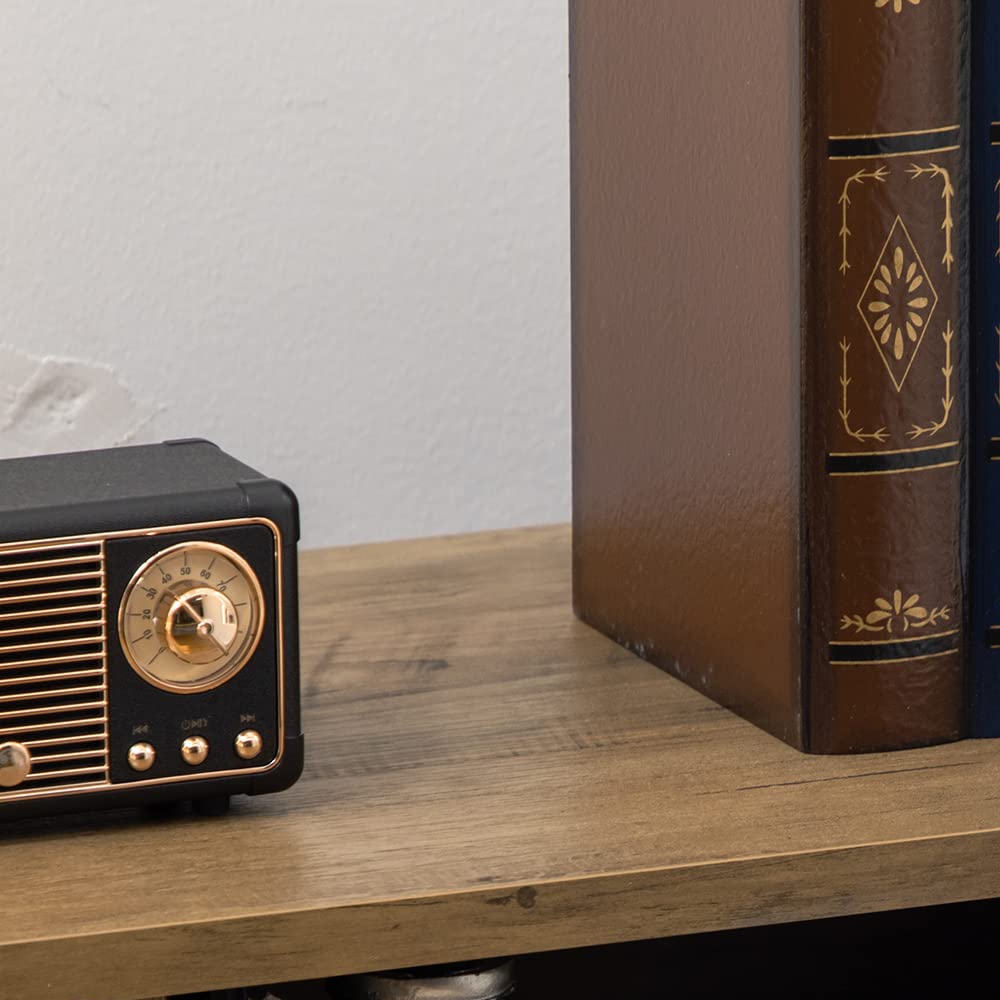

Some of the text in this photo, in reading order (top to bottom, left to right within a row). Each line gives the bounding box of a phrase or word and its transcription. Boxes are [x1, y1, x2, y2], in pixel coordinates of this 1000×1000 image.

[180, 567, 191, 575] 50
[200, 570, 210, 579] 60
[162, 574, 172, 584] 40
[146, 588, 157, 600] 30
[142, 609, 151, 619] 20
[144, 629, 153, 640] 10
